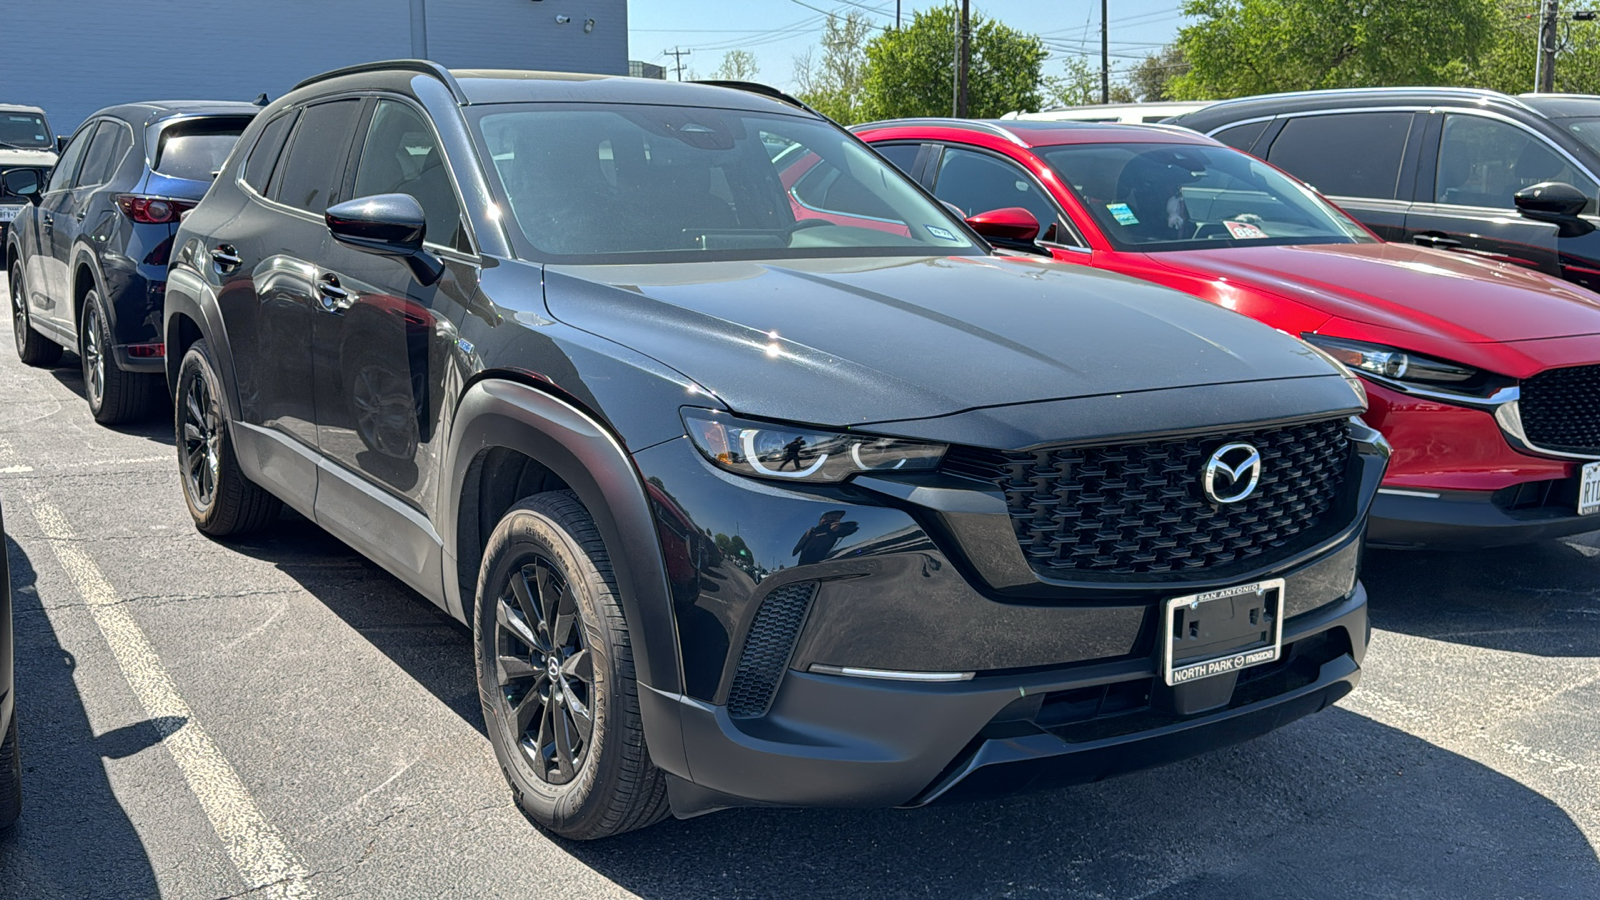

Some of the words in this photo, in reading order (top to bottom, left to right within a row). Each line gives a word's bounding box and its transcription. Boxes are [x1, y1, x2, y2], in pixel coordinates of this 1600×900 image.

[1198, 593, 1217, 601] SAN
[1219, 585, 1258, 598] ANTONIO
[1174, 666, 1206, 682] NORTH
[1208, 659, 1234, 674] PARK
[1246, 650, 1274, 664] mazda
